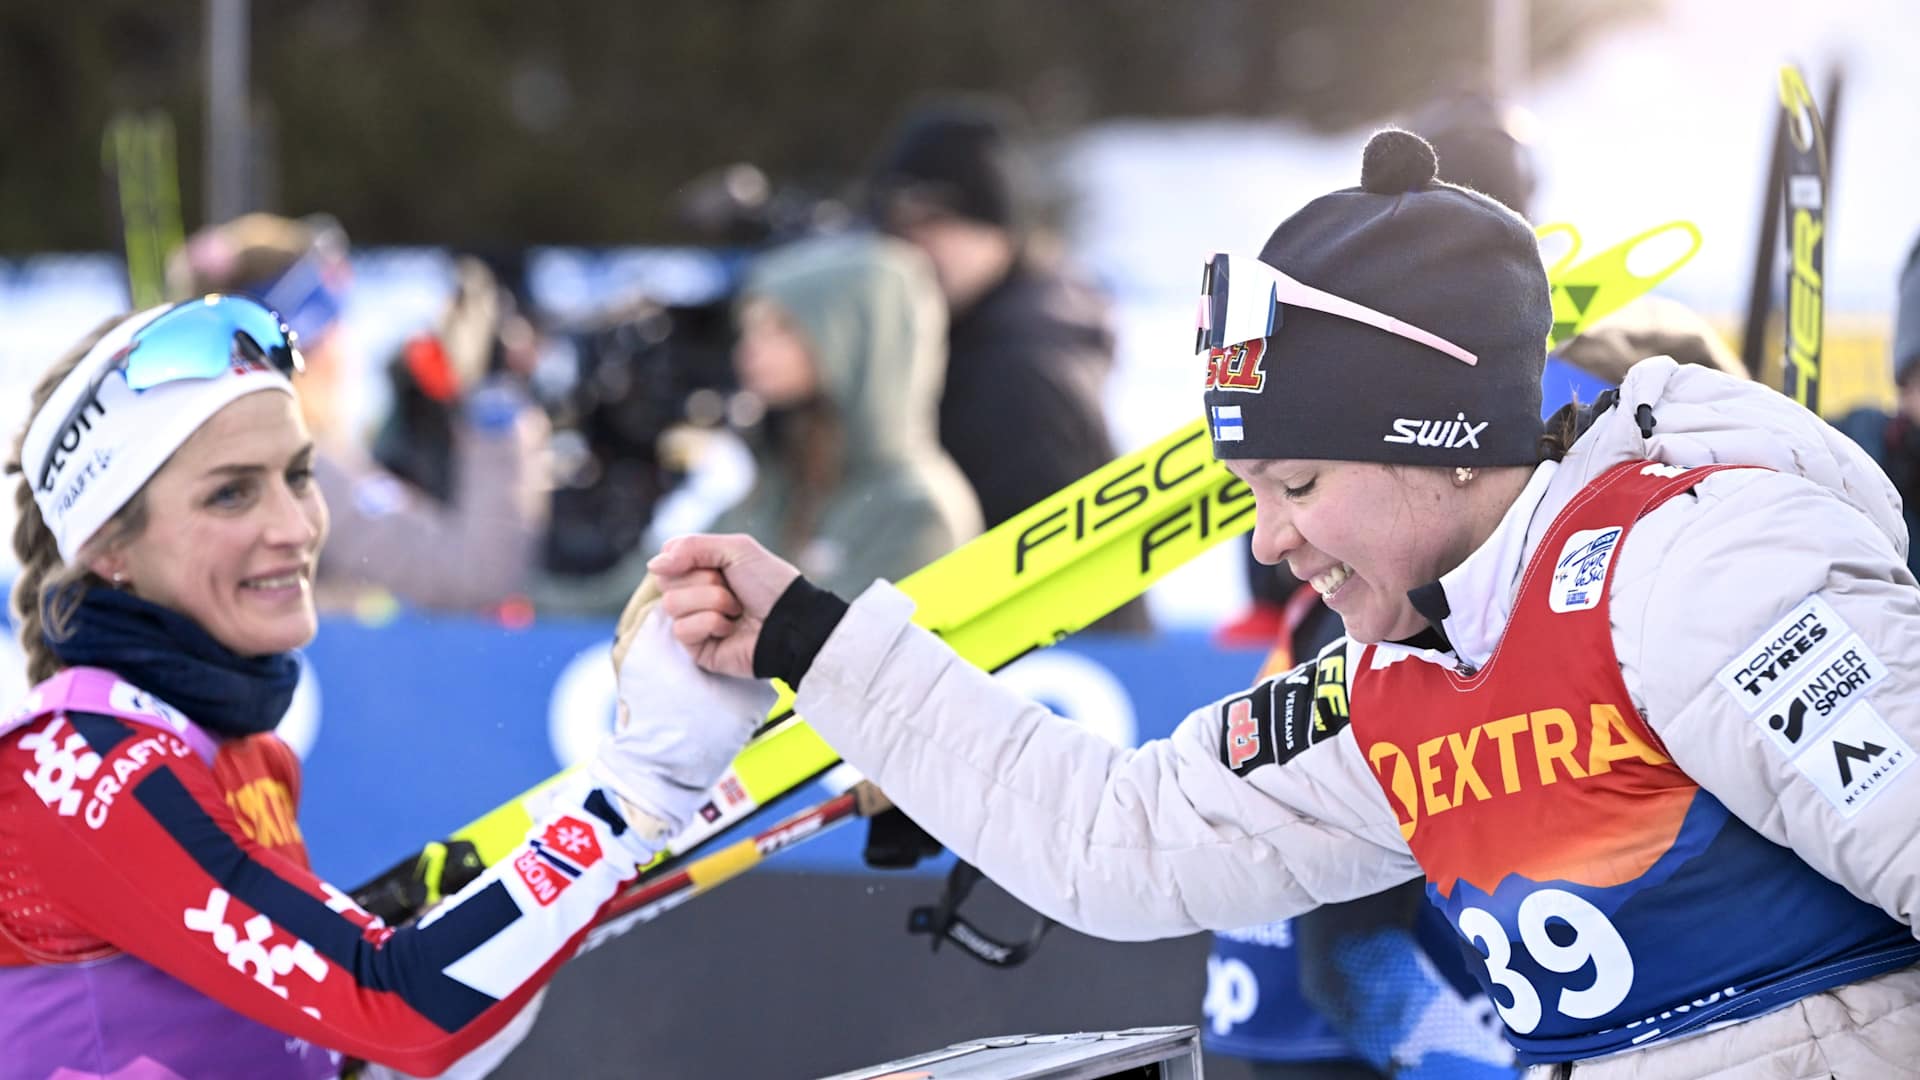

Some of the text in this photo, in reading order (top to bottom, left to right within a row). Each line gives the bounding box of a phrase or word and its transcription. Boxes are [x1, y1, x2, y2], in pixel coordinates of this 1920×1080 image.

[1743, 622, 1828, 696] TYRES
[1802, 649, 1862, 703] INTER
[1814, 663, 1872, 717] SPORT
[1284, 690, 1297, 751] VEIKKAUS
[85, 738, 167, 829] CRAFT
[1417, 703, 1671, 817] EXTRA
[514, 847, 557, 904] NOR
[1458, 889, 1635, 1035] 39
